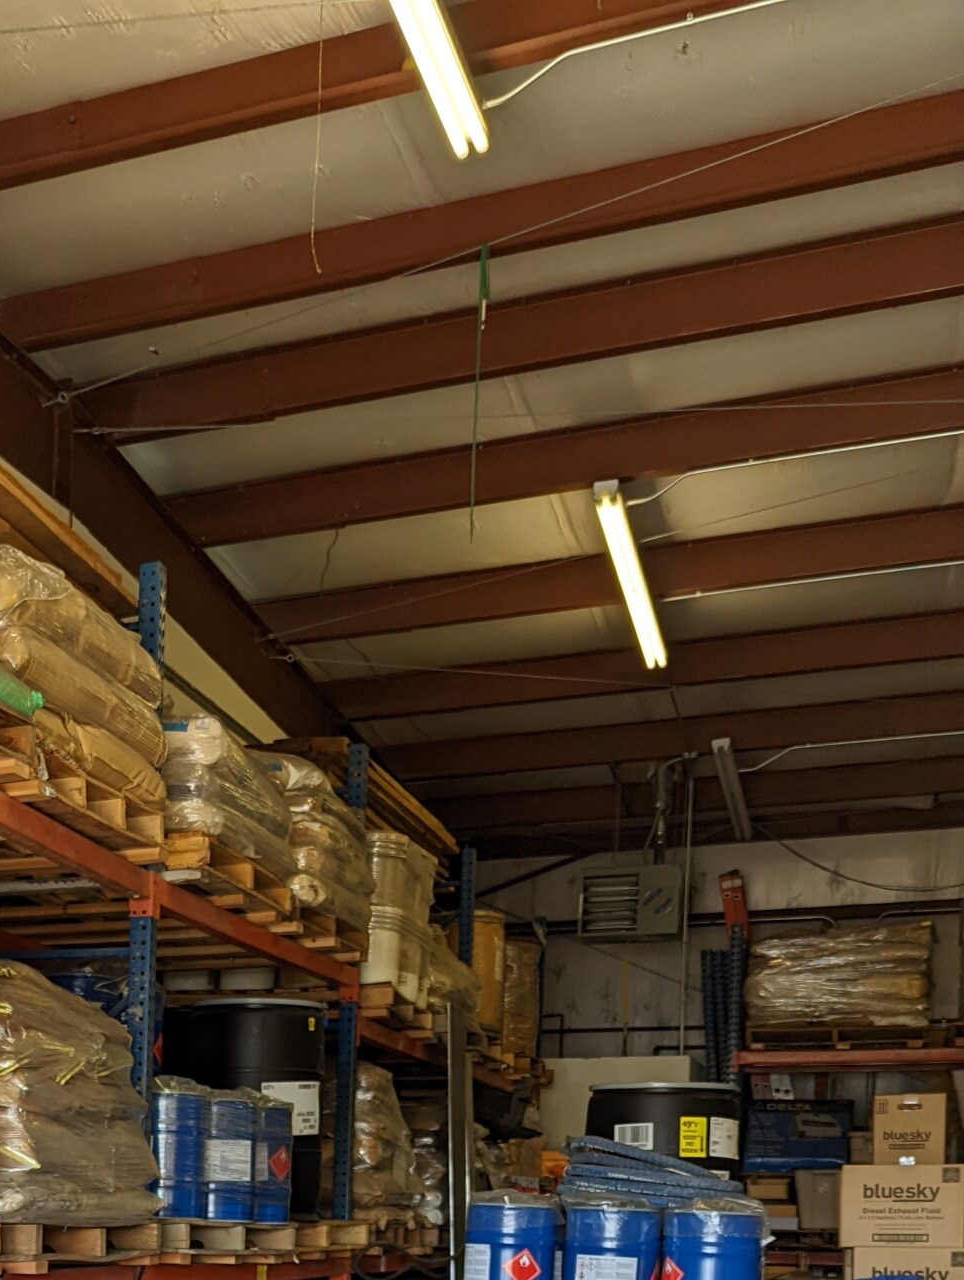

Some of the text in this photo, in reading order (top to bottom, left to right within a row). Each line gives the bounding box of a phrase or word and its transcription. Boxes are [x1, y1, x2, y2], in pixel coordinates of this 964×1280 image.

[882, 1130, 932, 1142] bluesky
[863, 1183, 941, 1202] bluesky
[862, 1207, 941, 1215] Diesel Exhaust Fluid
